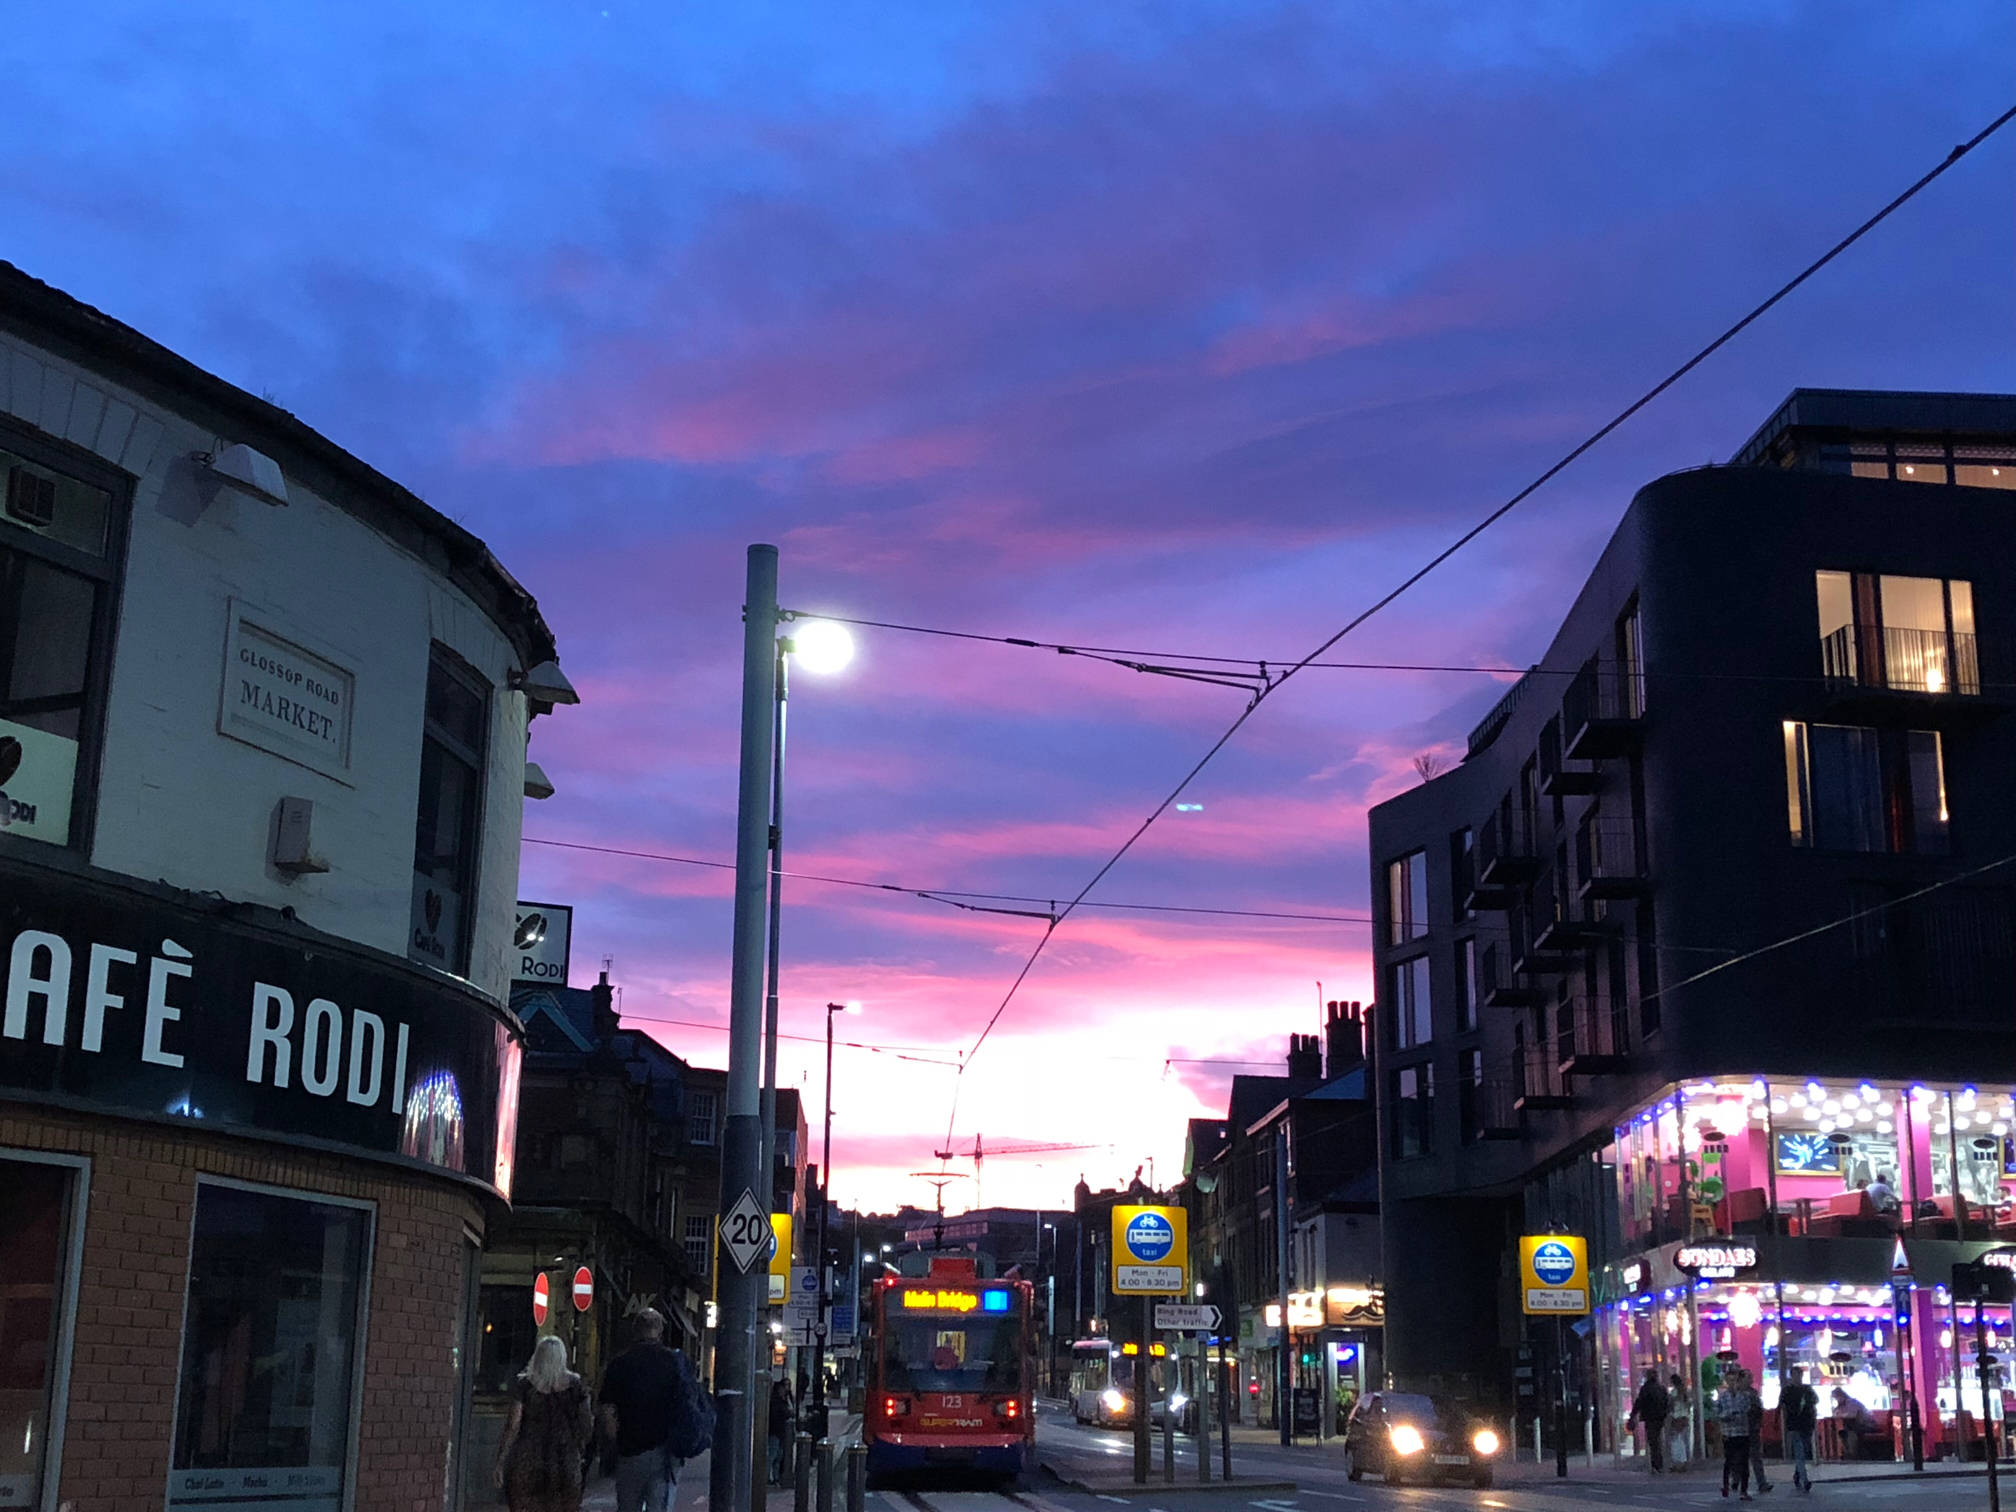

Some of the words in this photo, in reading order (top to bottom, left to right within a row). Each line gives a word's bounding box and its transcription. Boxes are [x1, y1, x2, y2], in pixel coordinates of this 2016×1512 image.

[240, 648, 303, 685] GLOSSOP
[305, 678, 339, 705] ROAD
[246, 981, 410, 1115] RODI
[731, 1213, 762, 1246] 20
[1142, 1248, 1158, 1256] taxi
[1678, 1248, 1756, 1267] SUNDAES
[1157, 1269, 1169, 1277] Fri
[1167, 1280, 1180, 1288] pm
[941, 1395, 962, 1408] 123
